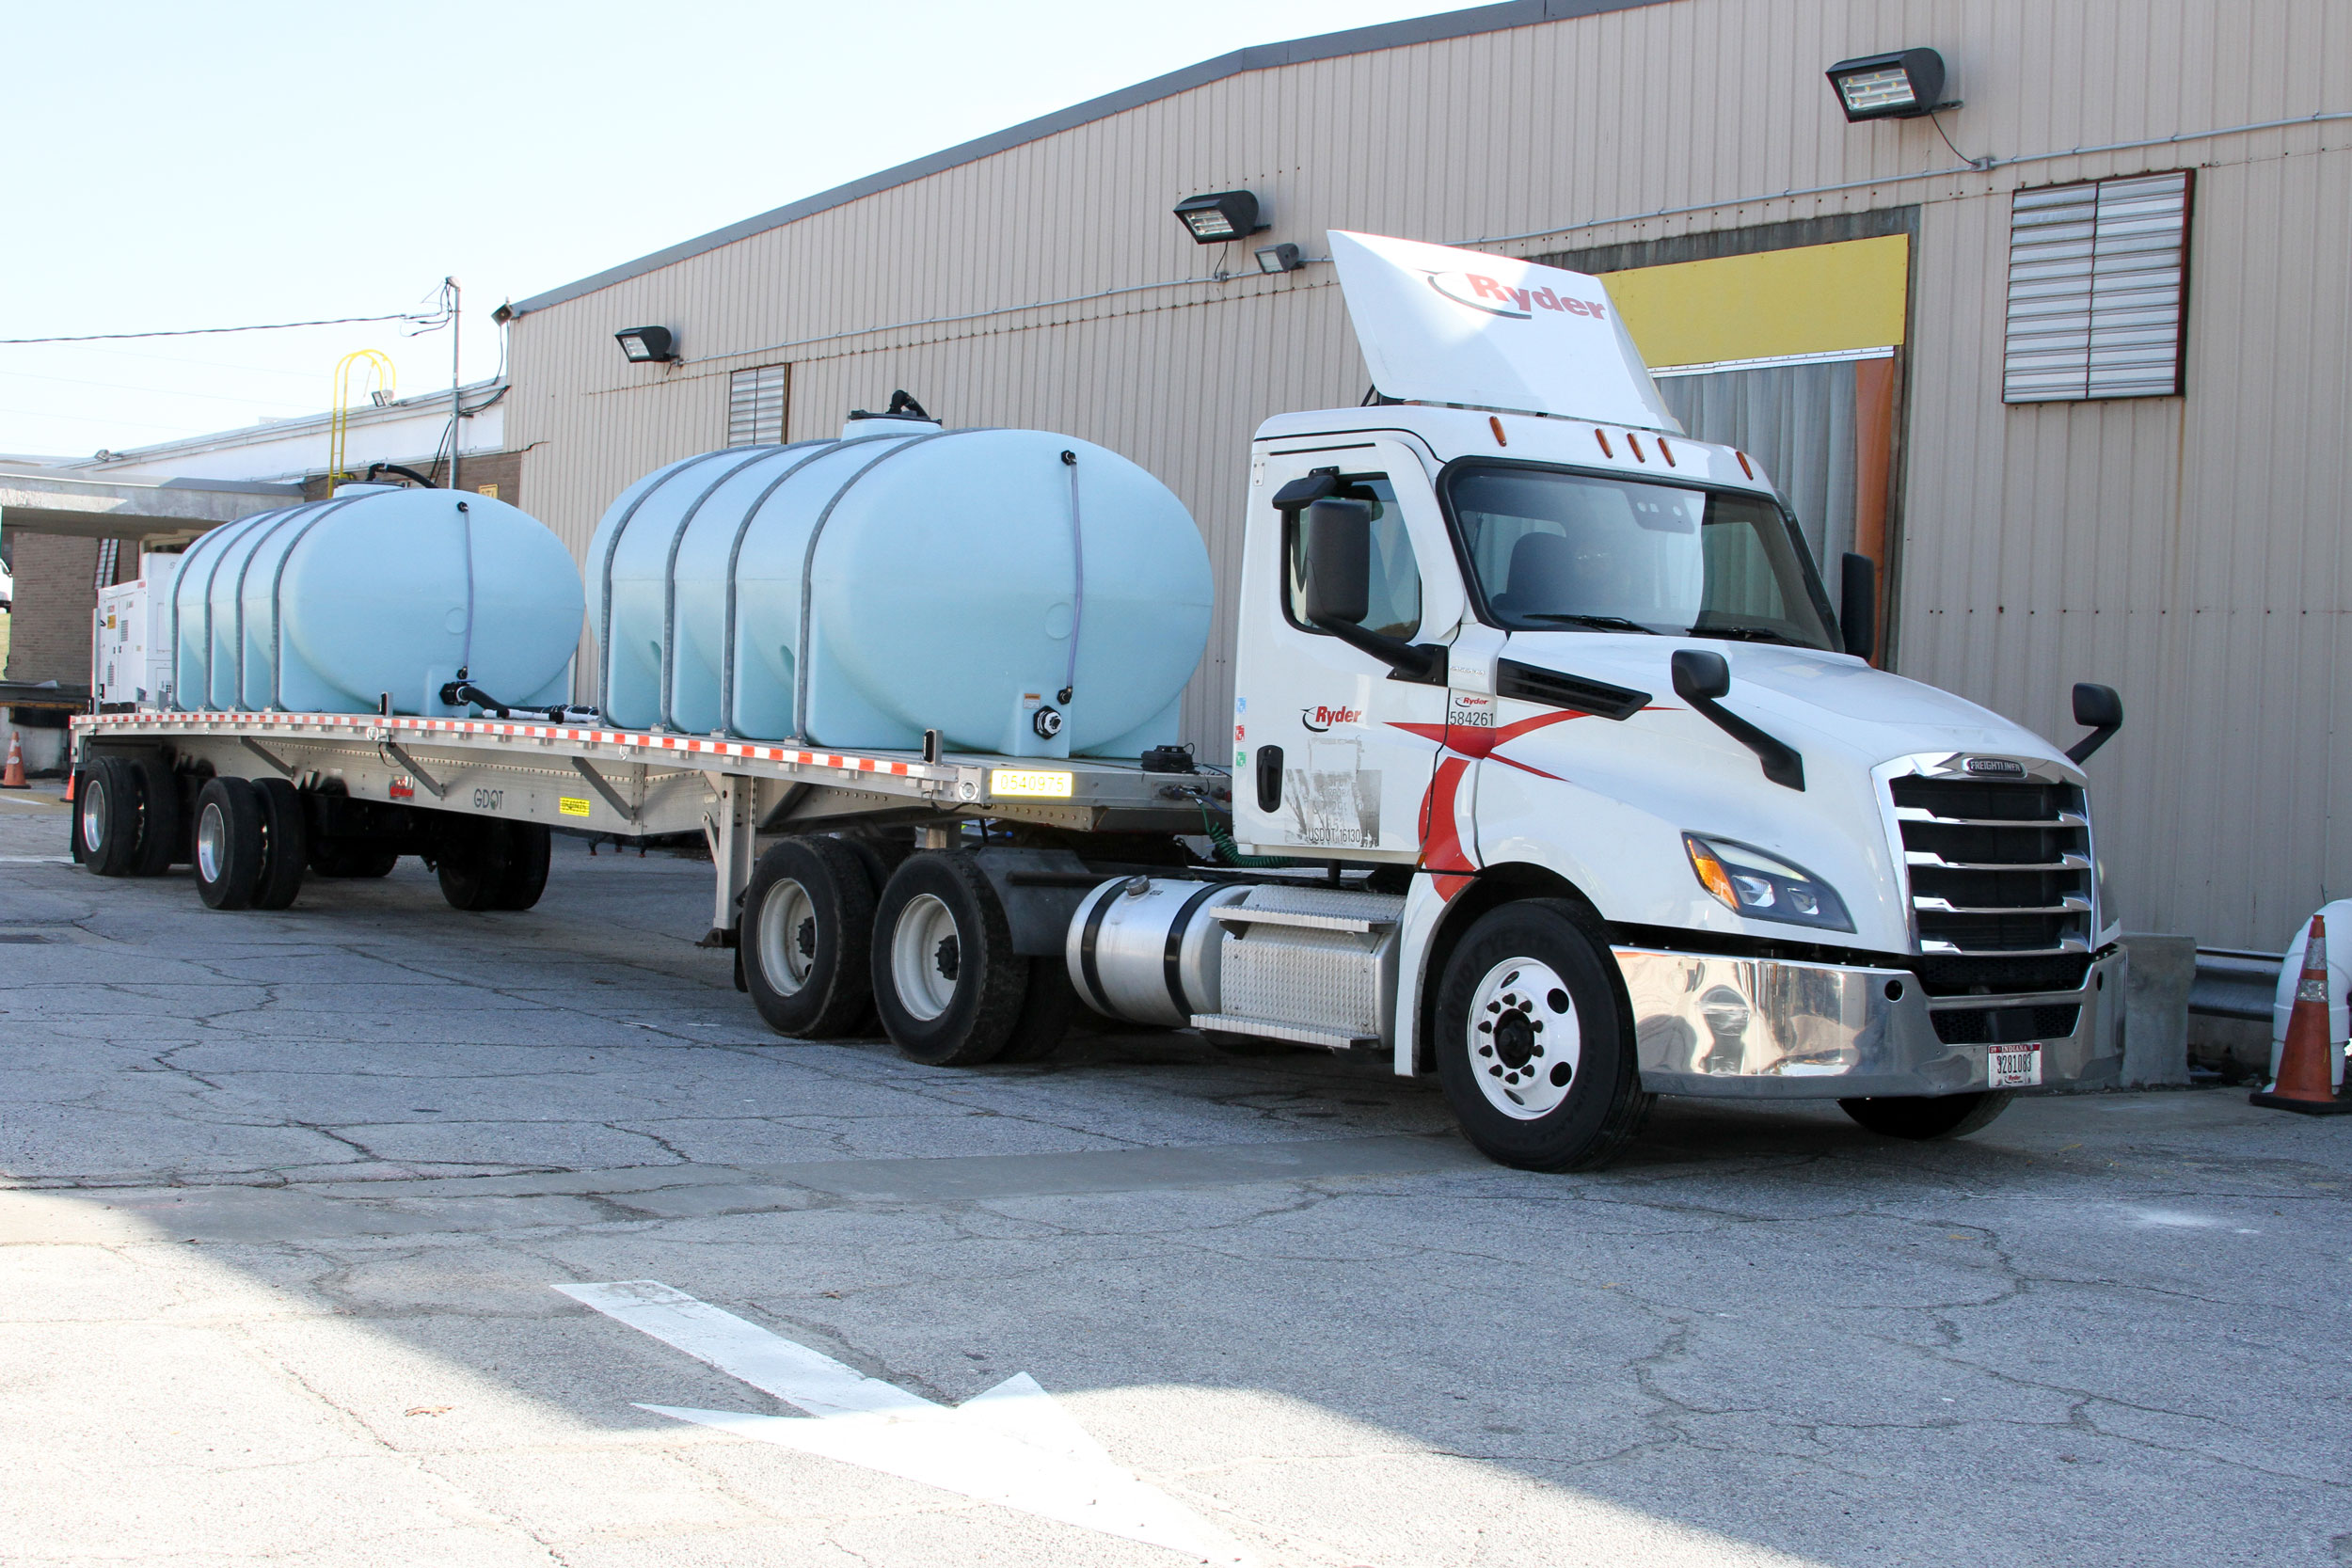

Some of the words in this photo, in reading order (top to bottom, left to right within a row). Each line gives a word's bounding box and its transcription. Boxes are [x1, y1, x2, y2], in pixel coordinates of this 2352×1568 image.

[1466, 273, 1606, 320] Ryder
[1463, 697, 1488, 705] Ryder
[1315, 705, 1362, 726] Ryder
[1450, 711, 1494, 727] 584261
[1970, 761, 2021, 771] FREIGHTLINER
[1000, 774, 1064, 792] 0540975
[473, 787, 503, 810] GDOT
[1308, 828, 1335, 842] USDOT
[1339, 829, 1361, 843] 16130
